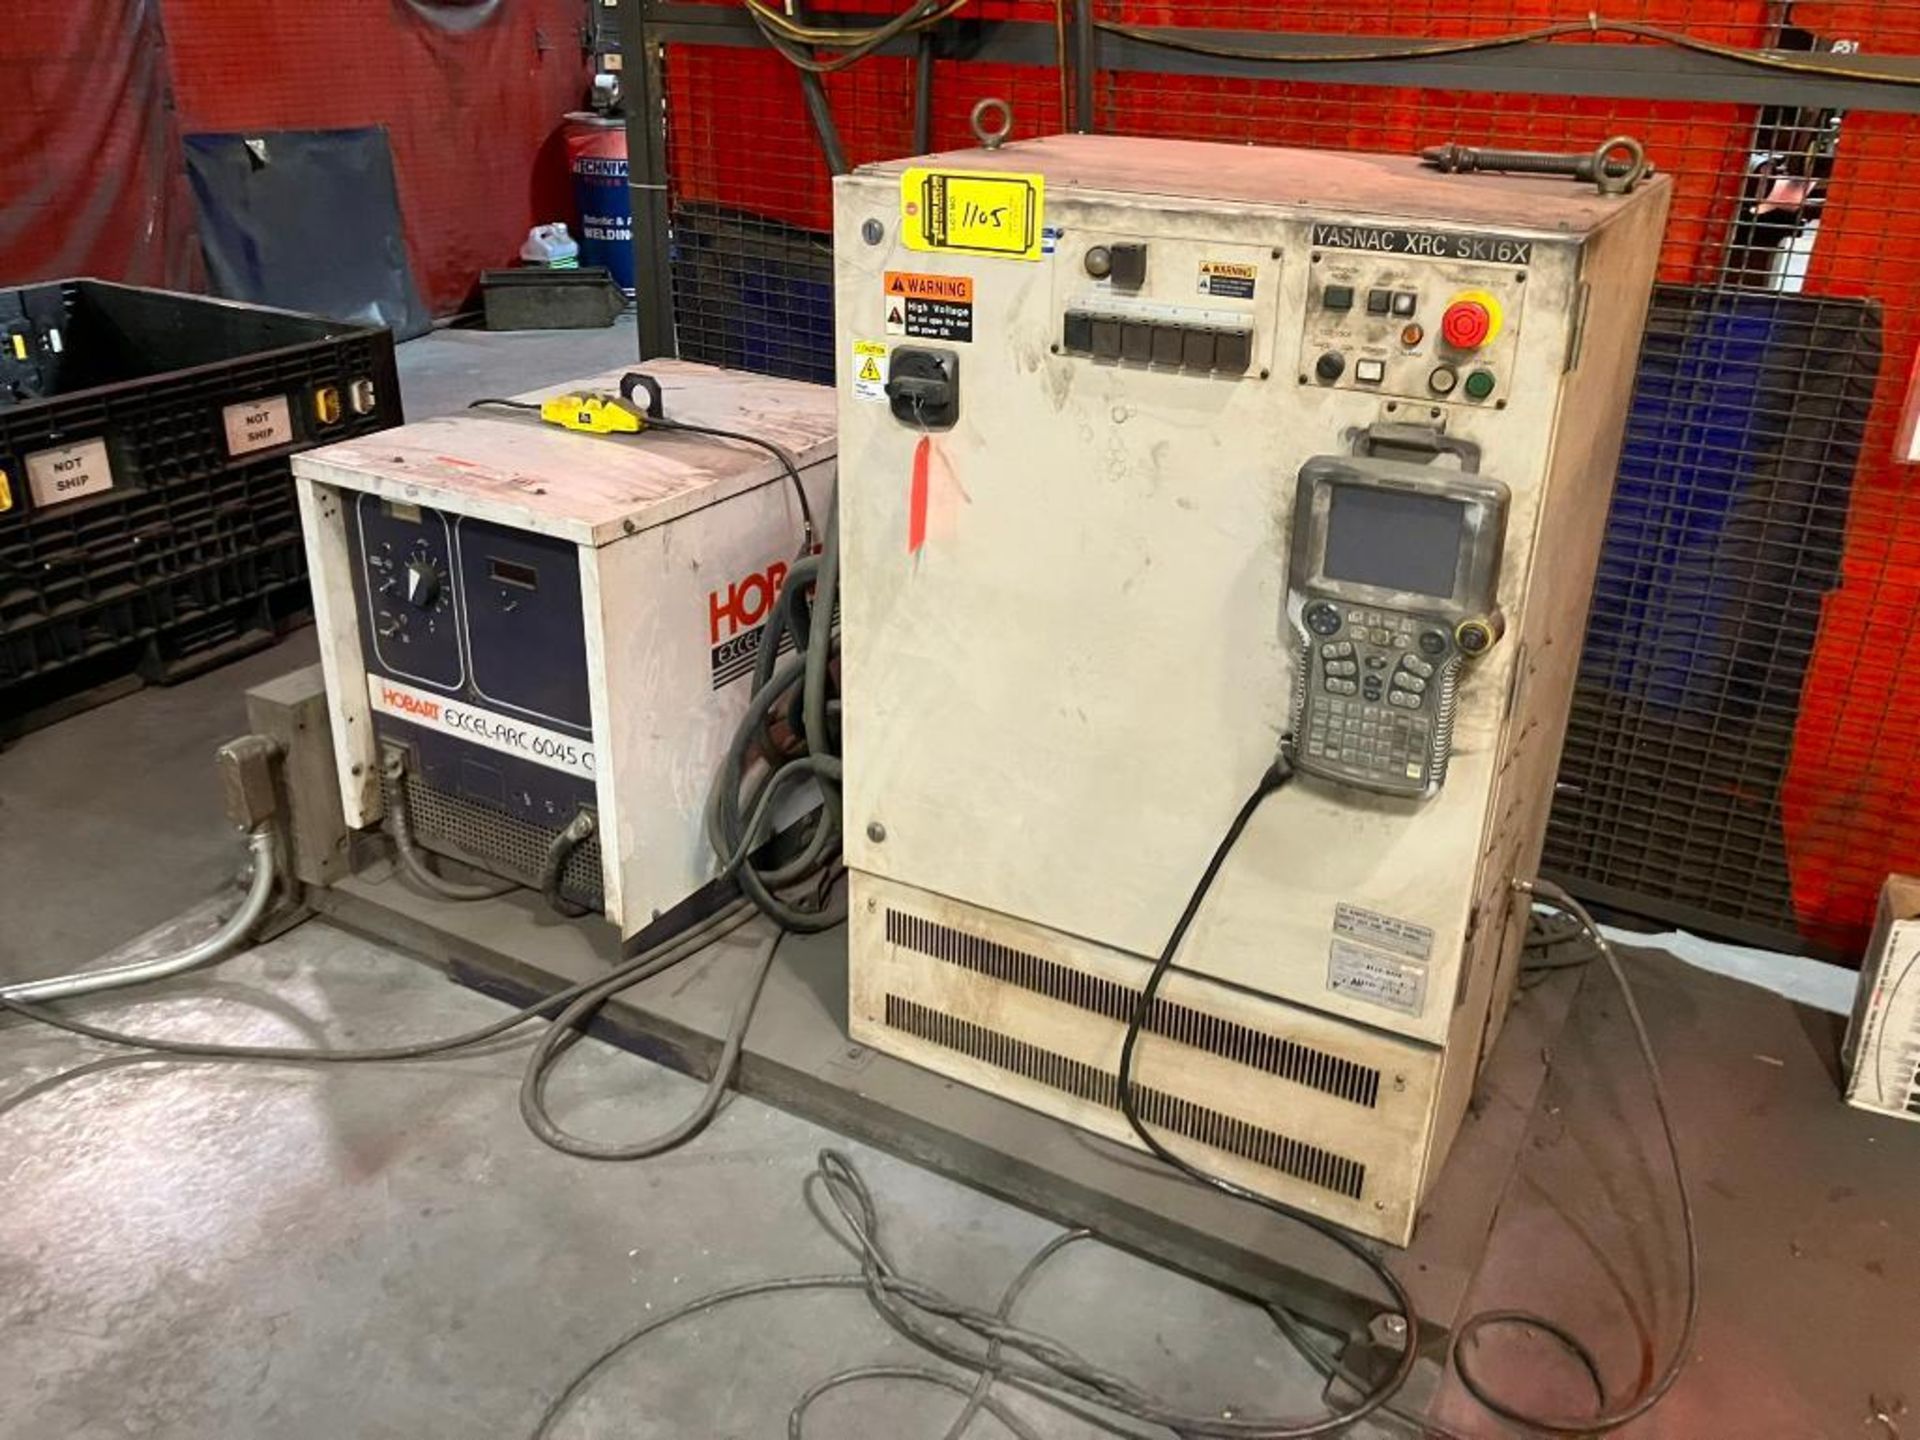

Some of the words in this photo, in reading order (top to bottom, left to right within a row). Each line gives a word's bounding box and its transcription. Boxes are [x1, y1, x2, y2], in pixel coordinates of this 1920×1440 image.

[962, 201, 1008, 228] 1105
[1317, 226, 1395, 250] YASNAC
[1404, 233, 1448, 256] XRC
[1456, 237, 1529, 263] SK16X
[907, 279, 966, 297] WARNING
[908, 302, 928, 314] High
[932, 304, 969, 317] Voltage
[246, 411, 270, 425] NOT
[247, 427, 274, 442] SHIP
[54, 457, 82, 473] NOT
[57, 475, 89, 491] SHIP
[382, 687, 440, 720] HOBART
[445, 708, 529, 750] EXCEL-ARC
[532, 736, 578, 765] 6045
